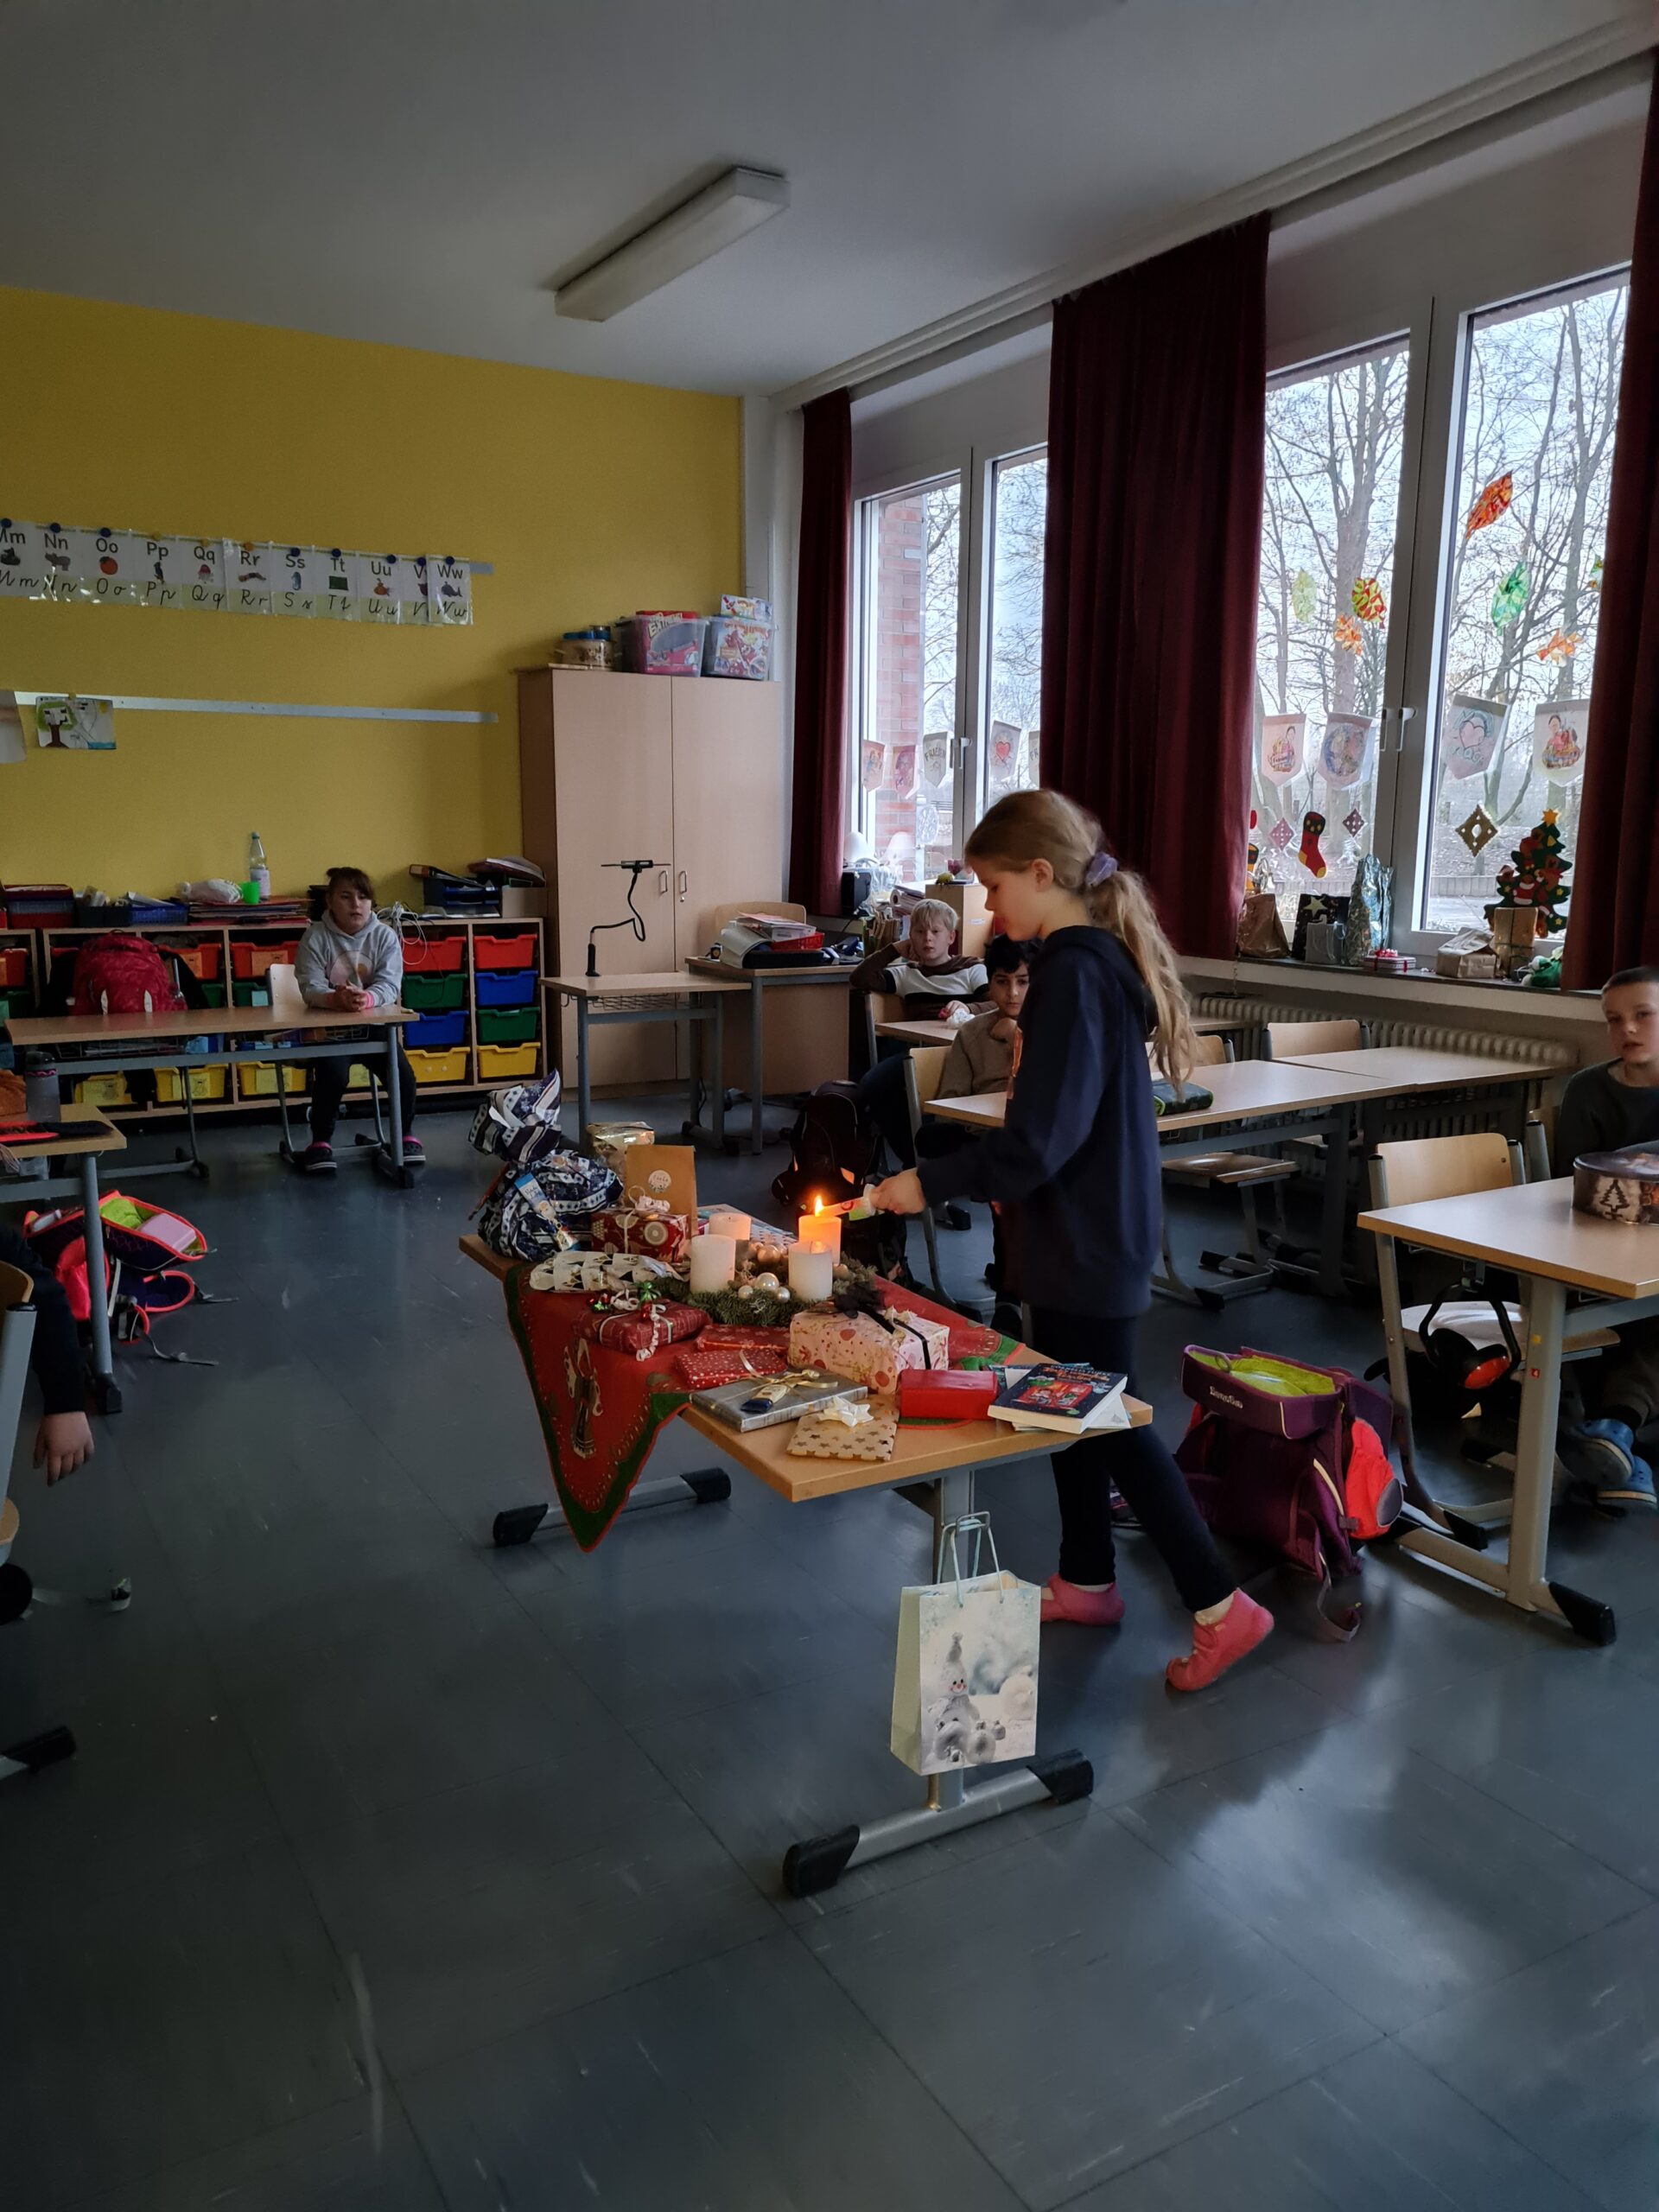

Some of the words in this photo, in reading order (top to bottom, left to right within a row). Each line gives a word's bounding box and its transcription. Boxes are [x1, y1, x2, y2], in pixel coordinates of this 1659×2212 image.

[45, 532, 68, 550] Nn
[96, 537, 118, 553] Oo
[147, 542, 168, 560] Pp
[194, 546, 215, 564] Qq
[240, 550, 260, 565] Rr
[286, 555, 305, 569] Ss
[330, 557, 345, 572] Tt
[372, 561, 391, 576] Uu
[413, 564, 428, 579] V
[437, 564, 463, 579] Ww
